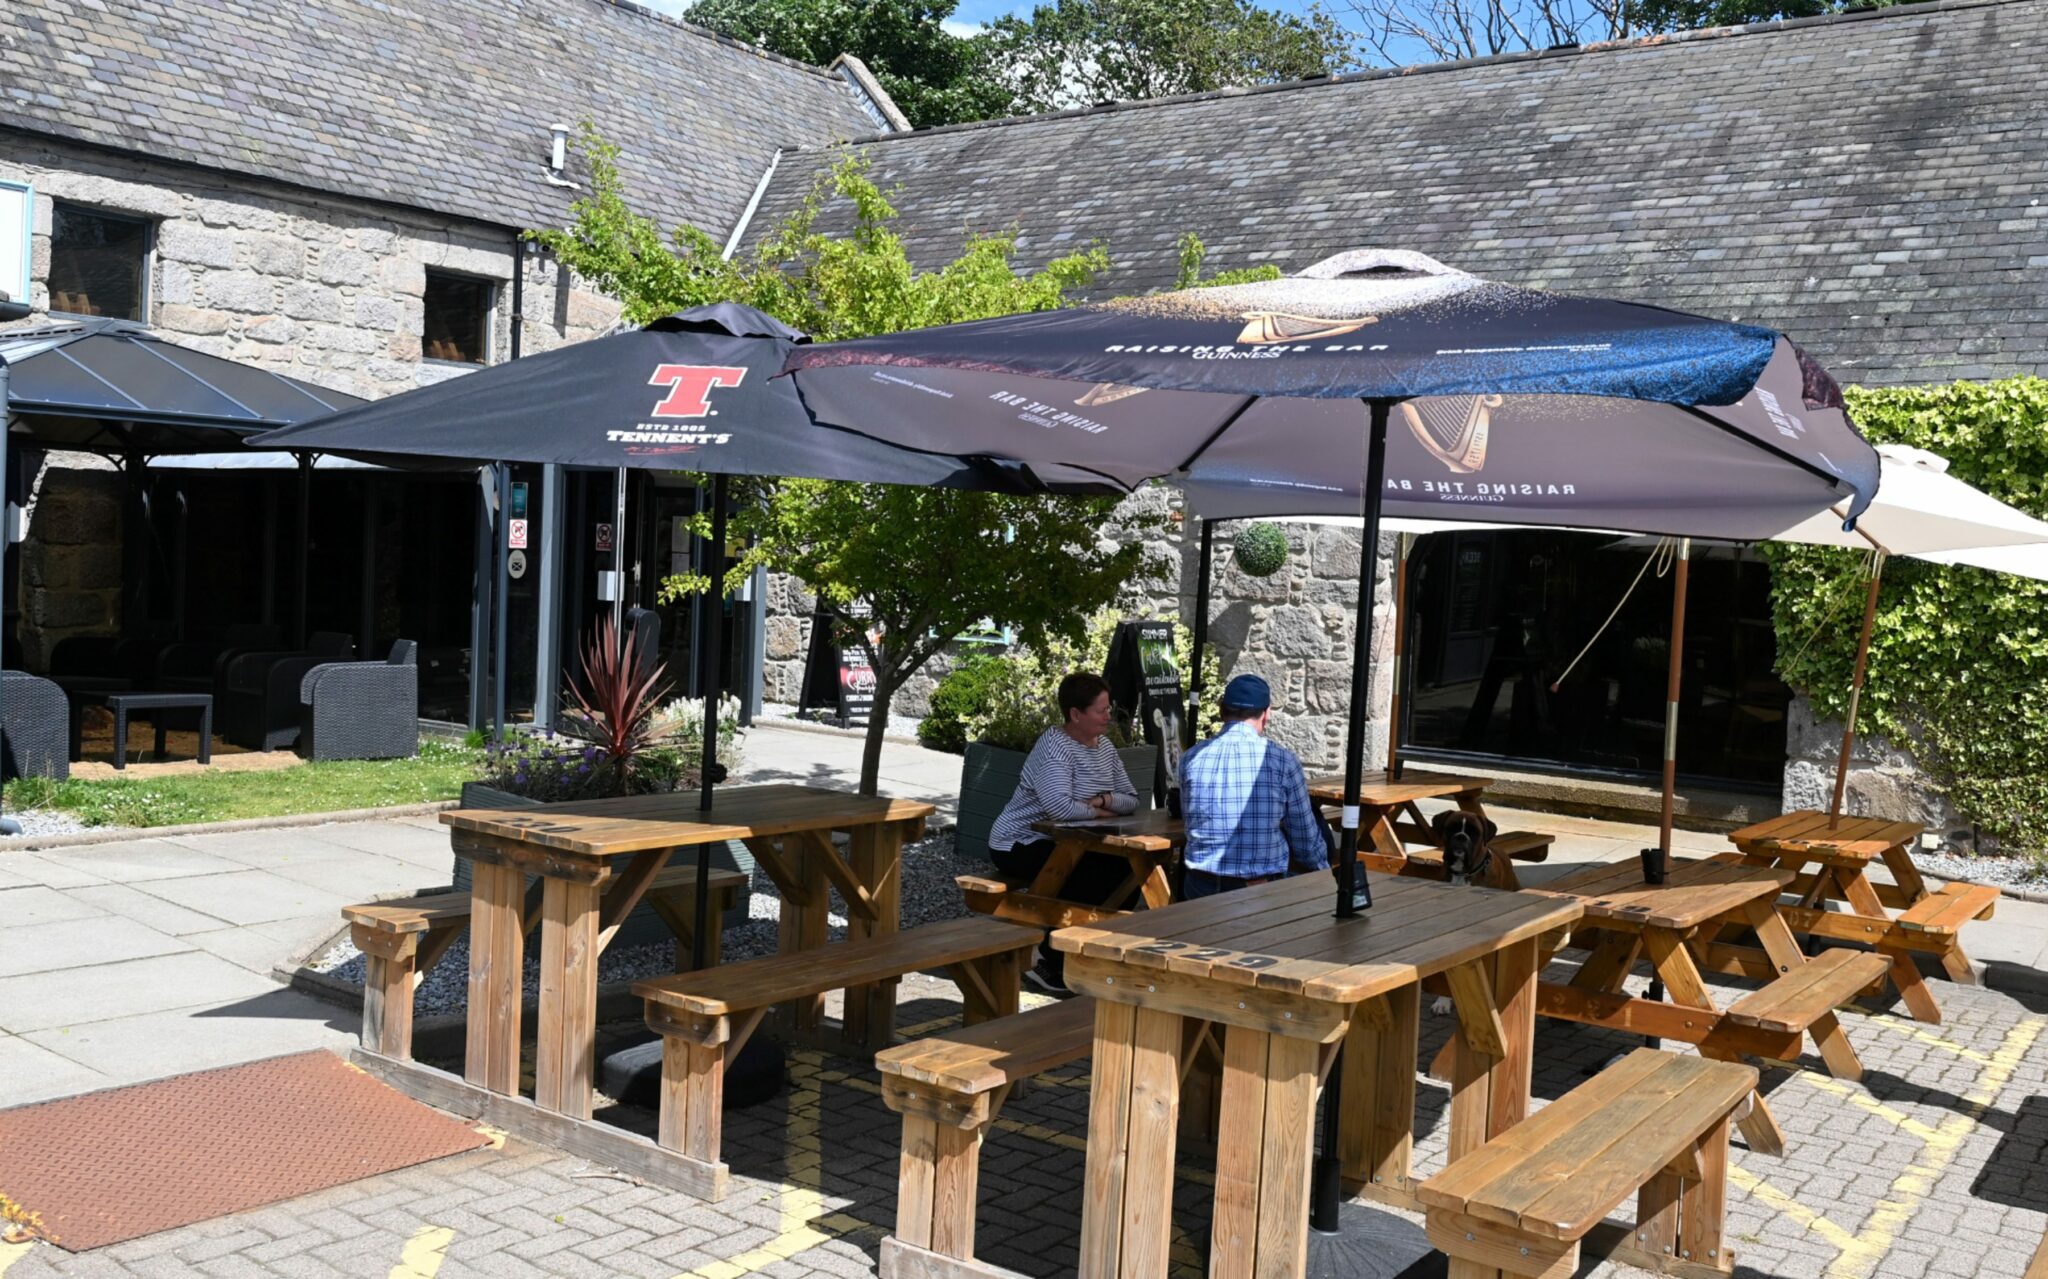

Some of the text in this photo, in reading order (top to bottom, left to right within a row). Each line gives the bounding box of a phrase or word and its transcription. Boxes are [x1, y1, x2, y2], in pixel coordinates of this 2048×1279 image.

[1250, 345, 1313, 353] THE
[1191, 350, 1283, 360] GUINNESS
[606, 430, 734, 444] TENNENT'S
